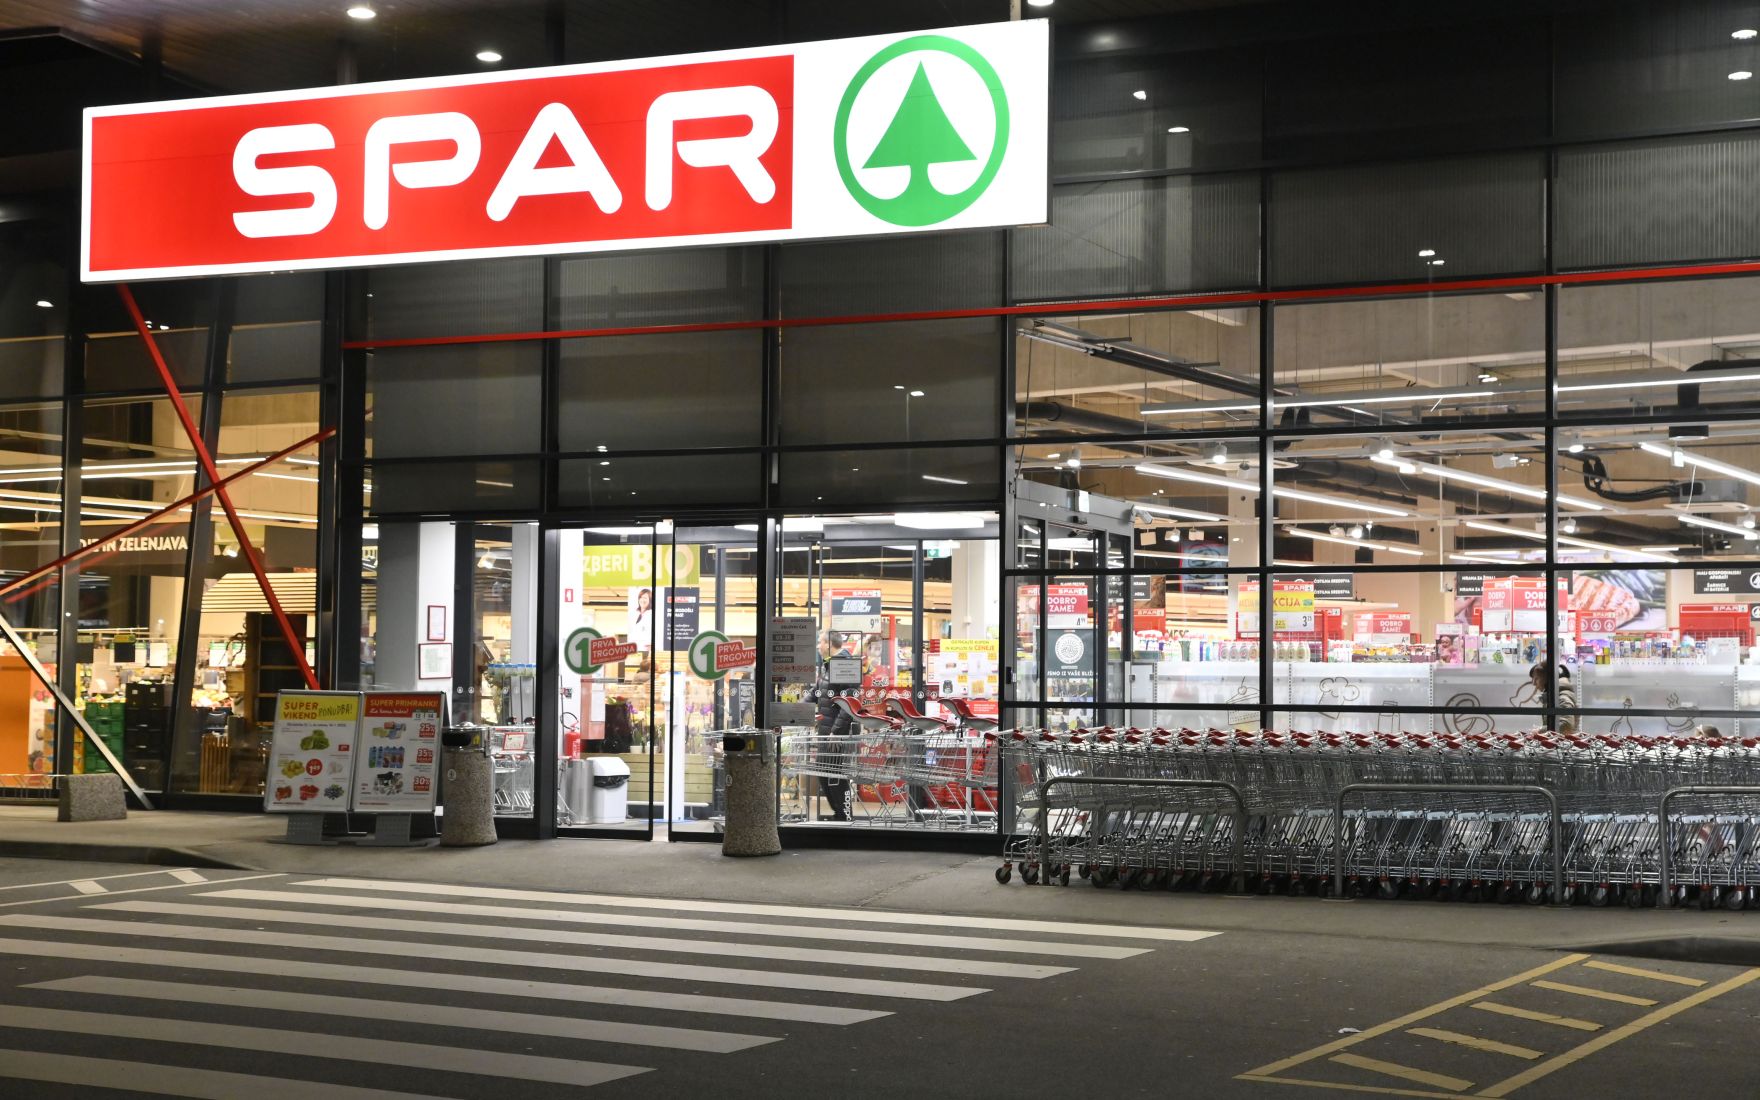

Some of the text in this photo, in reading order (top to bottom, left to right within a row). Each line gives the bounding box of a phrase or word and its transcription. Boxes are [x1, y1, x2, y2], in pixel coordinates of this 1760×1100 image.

[232, 85, 780, 239] SPAR
[119, 536, 188, 551] ZELENJAVA
[583, 543, 694, 581] ZBERI BIO
[1524, 591, 1546, 600] DOB
[1273, 597, 1301, 607] KCIJA
[1527, 601, 1546, 609] ZAM
[1049, 605, 1075, 613] ZAME!
[592, 640, 614, 650] PRVA
[718, 644, 741, 654] PRVA
[592, 645, 635, 658] TRGOVINA
[718, 650, 756, 663] TRGOVIN
[284, 702, 318, 711] SUPER
[370, 699, 394, 707] SUPER
[283, 711, 317, 720] VIKEND
